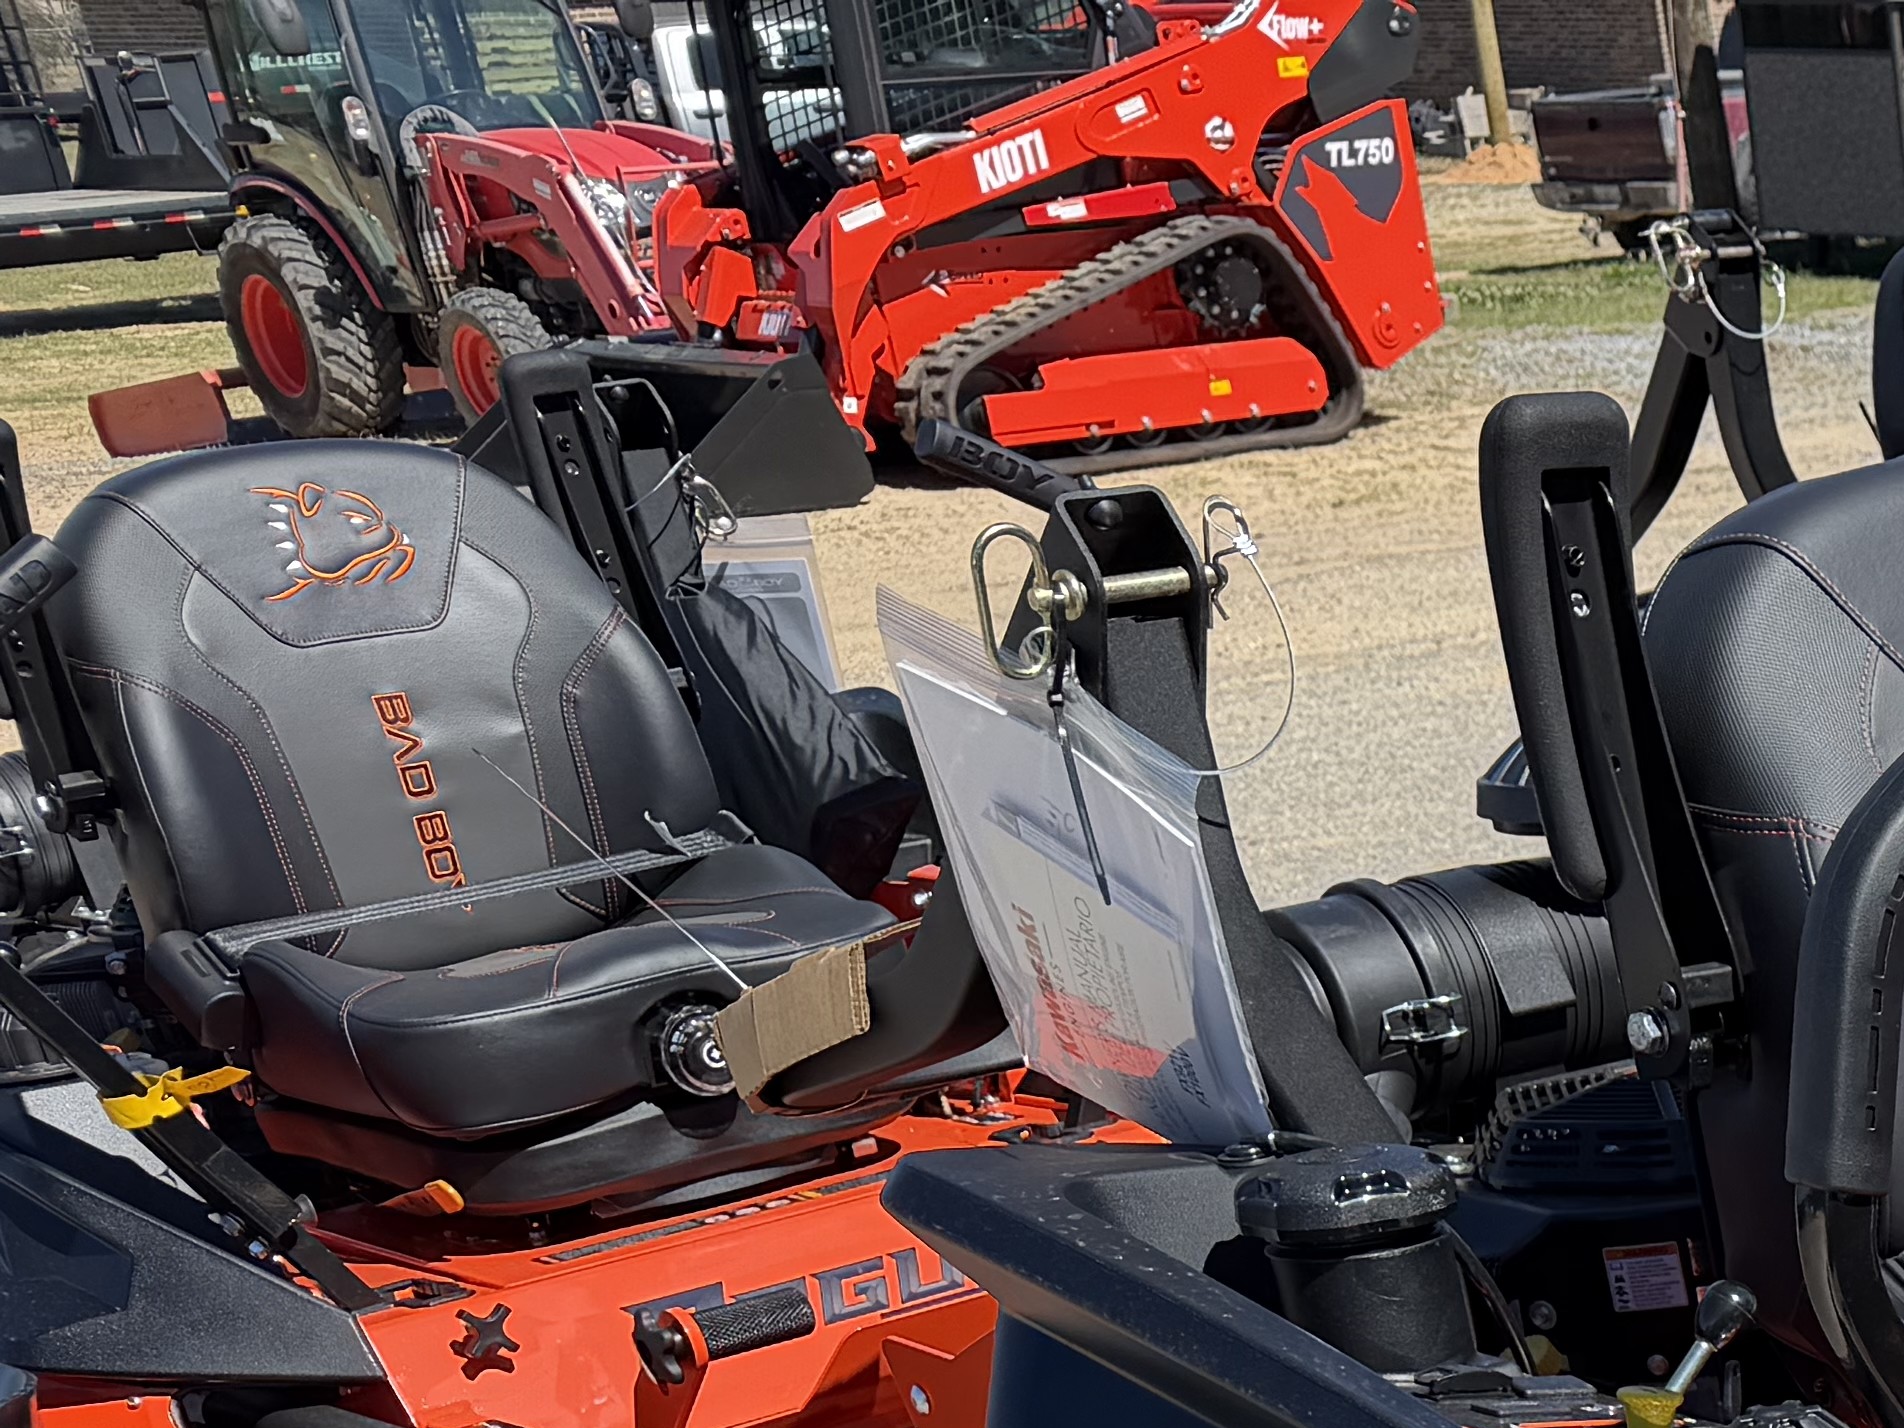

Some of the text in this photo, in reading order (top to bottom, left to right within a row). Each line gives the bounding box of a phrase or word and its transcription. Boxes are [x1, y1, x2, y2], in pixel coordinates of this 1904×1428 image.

[973, 129, 1050, 195] KIOTI
[1325, 137, 1395, 168] TL750
[948, 435, 1053, 491] BOY
[370, 690, 474, 914] BAD BO
